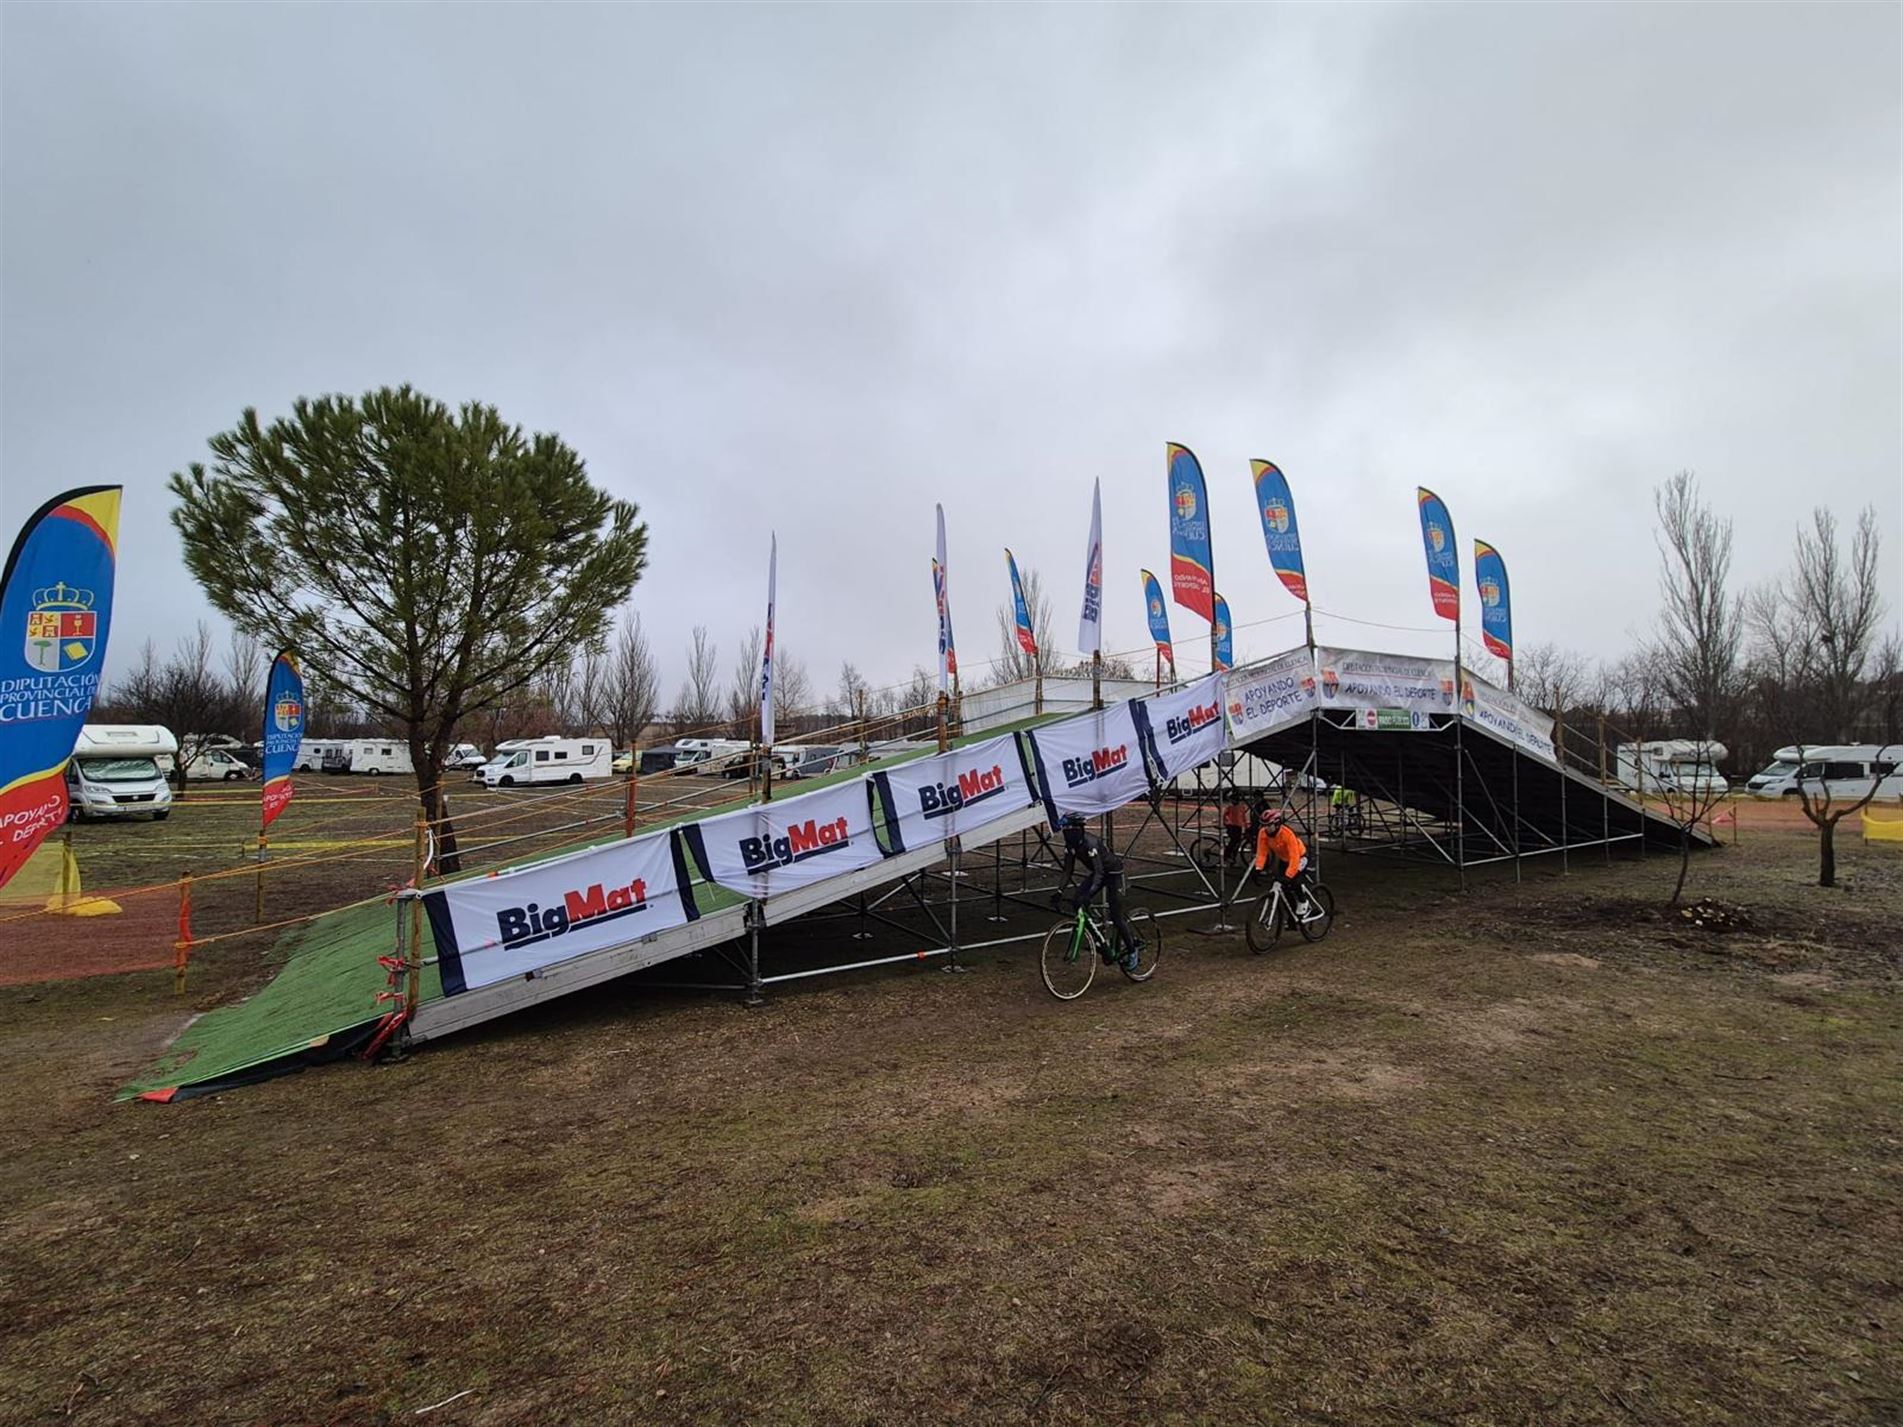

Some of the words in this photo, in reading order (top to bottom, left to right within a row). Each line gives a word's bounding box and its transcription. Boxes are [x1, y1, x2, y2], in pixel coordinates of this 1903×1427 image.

[0, 687, 84, 704] PROVINCIAL
[1245, 677, 1294, 704] APOYANDO
[1246, 708, 1258, 720] EL
[1260, 691, 1302, 715] DEPORTE
[1166, 700, 1219, 738] BigMat
[1062, 745, 1128, 783] BigMat
[918, 765, 1004, 812] BigMat
[739, 816, 848, 868] BigMat
[497, 878, 646, 943] BigMat
